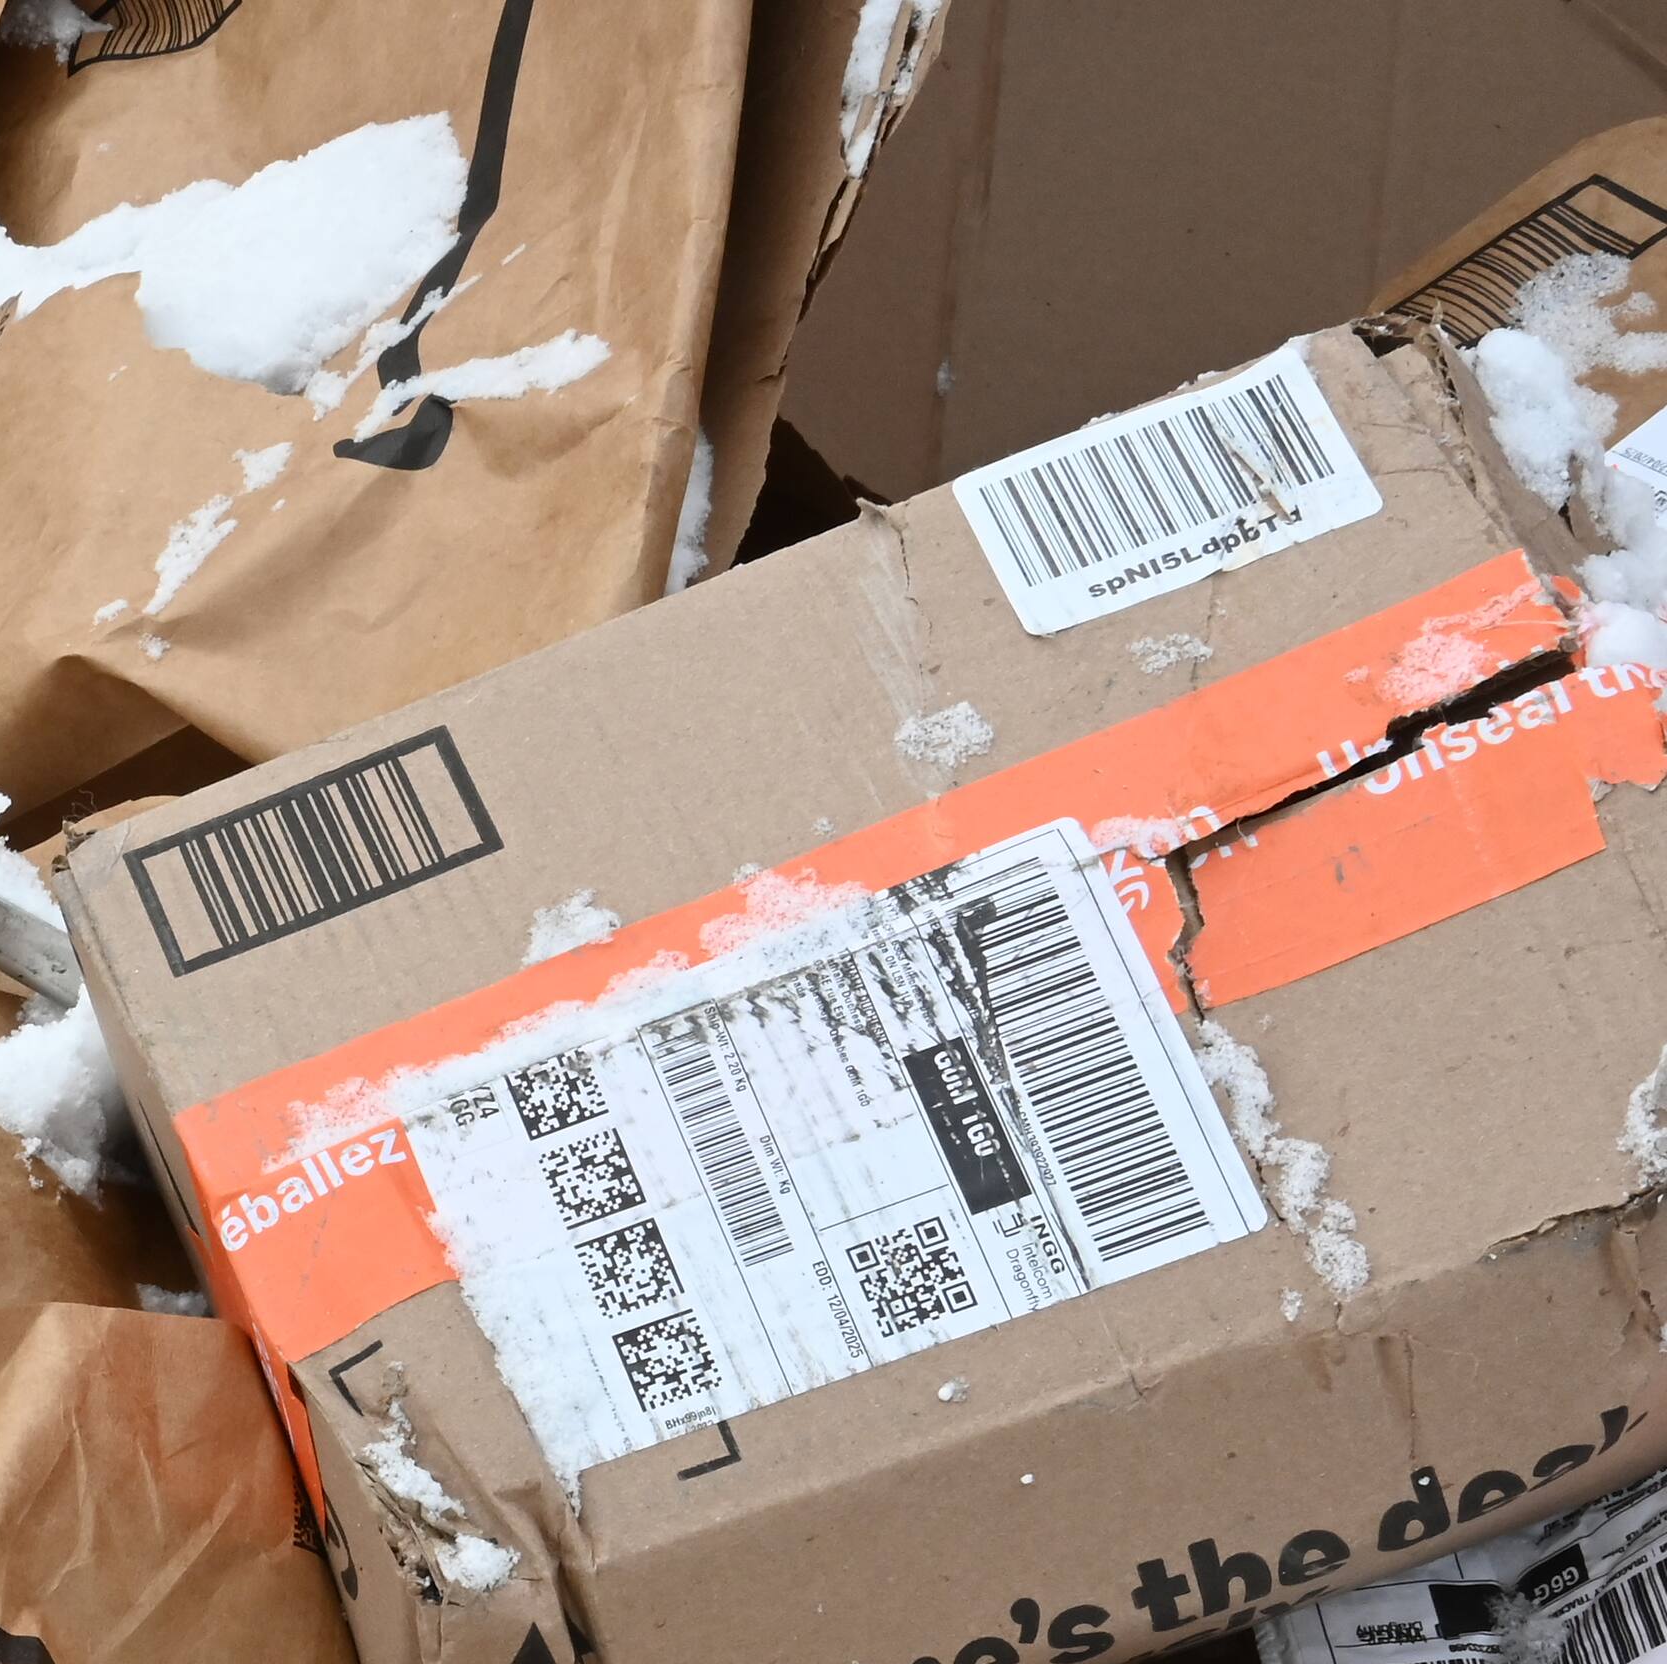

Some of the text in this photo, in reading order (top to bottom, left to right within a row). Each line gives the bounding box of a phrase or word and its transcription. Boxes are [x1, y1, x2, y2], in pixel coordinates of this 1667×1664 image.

[824, 986, 839, 1004] rue
[723, 1051, 741, 1077] 2.20
[735, 1075, 747, 1093] Kg
[219, 1127, 408, 1252] éballez
[759, 1134, 791, 1196] Dim Wt: Kg
[1022, 1243, 1053, 1300] Intelcom
[1030, 1214, 1066, 1274] INGG
[812, 1260, 864, 1360] EDD: 12/04/2025
[1006, 1248, 1040, 1312] Dragonfly
[1131, 1526, 1353, 1635] the
[1530, 1562, 1582, 1605] G6G
